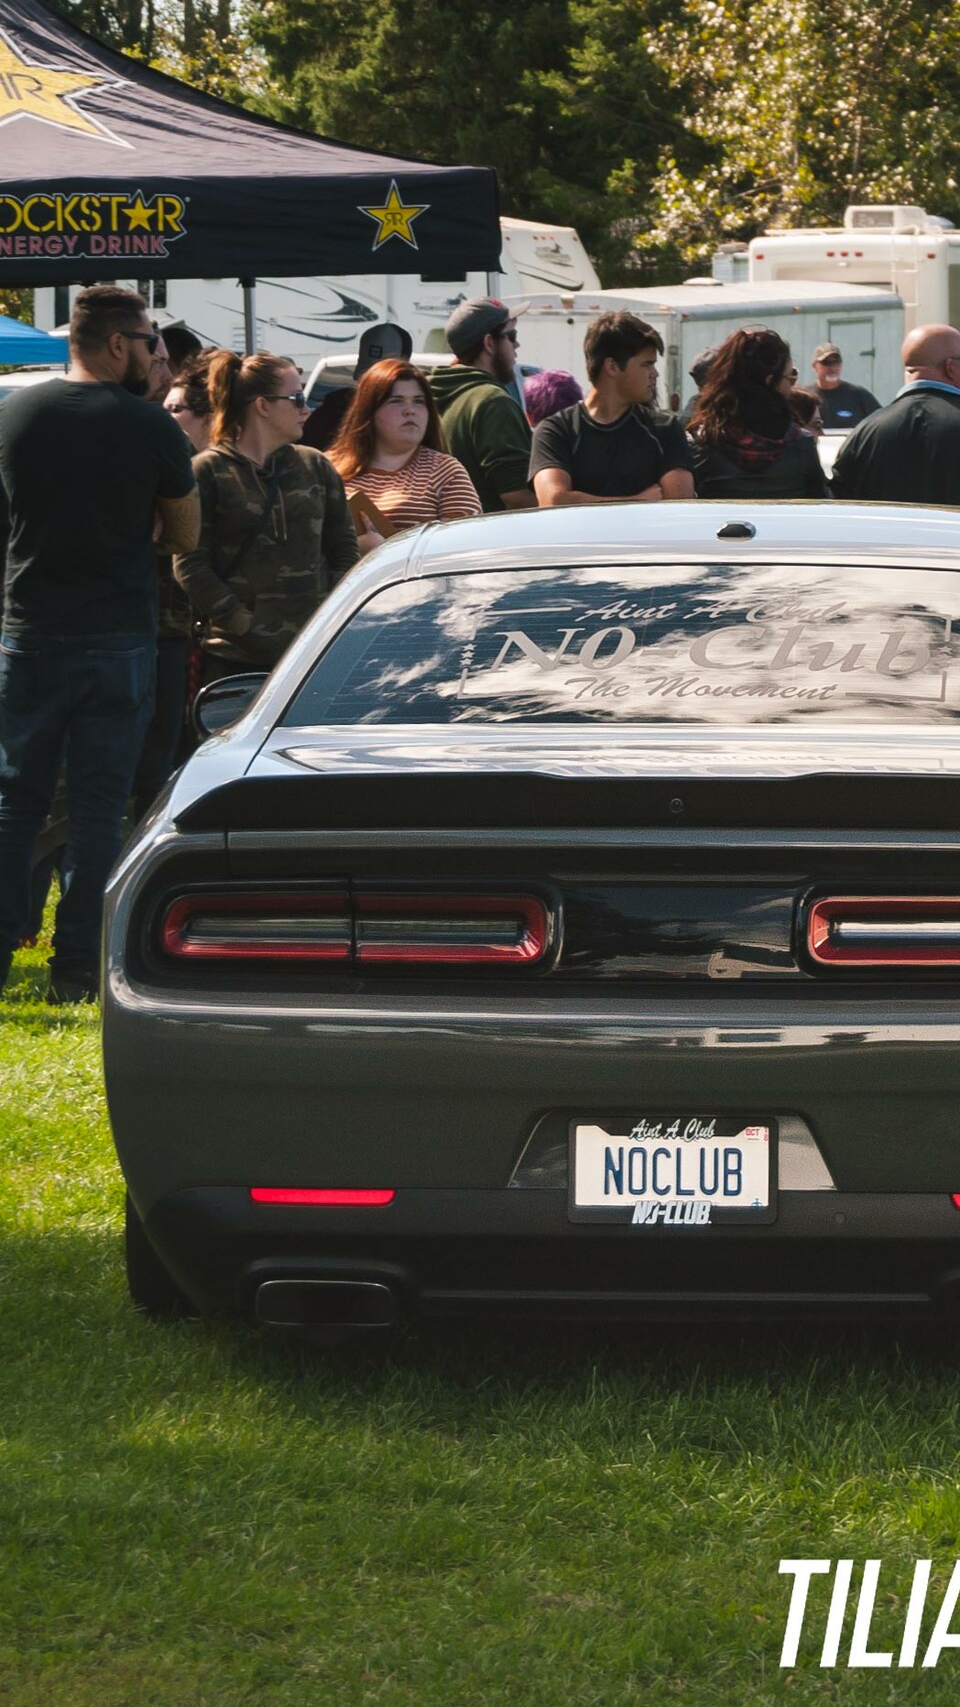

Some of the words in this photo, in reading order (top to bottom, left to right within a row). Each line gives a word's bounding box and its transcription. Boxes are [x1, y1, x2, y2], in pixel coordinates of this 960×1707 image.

[90, 235, 165, 254] DRINK
[684, 600, 735, 620] A
[564, 676, 632, 700] The
[645, 676, 838, 700] Movement
[664, 1118, 681, 1140] A
[684, 1118, 717, 1142] Club
[603, 1146, 742, 1196] NOCLUB
